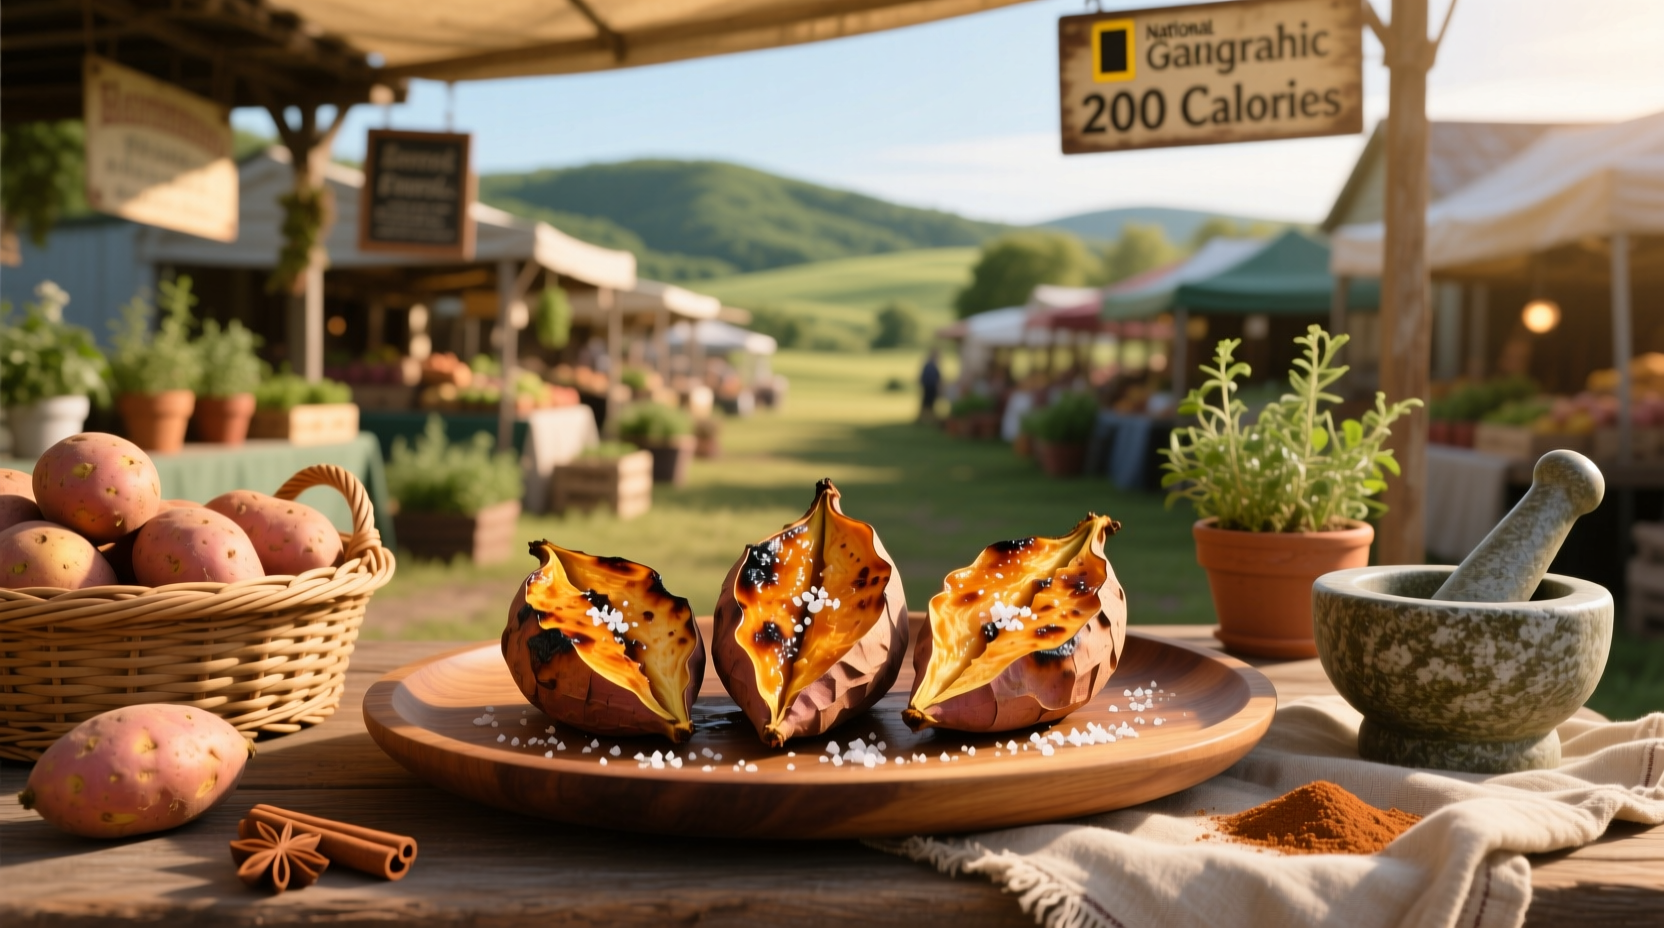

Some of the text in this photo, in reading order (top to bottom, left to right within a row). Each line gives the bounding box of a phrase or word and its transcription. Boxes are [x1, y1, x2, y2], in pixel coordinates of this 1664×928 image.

[1146, 20, 1214, 40] National
[1146, 22, 1329, 74] Gangrahic
[1082, 80, 1341, 134] 200 Calories
